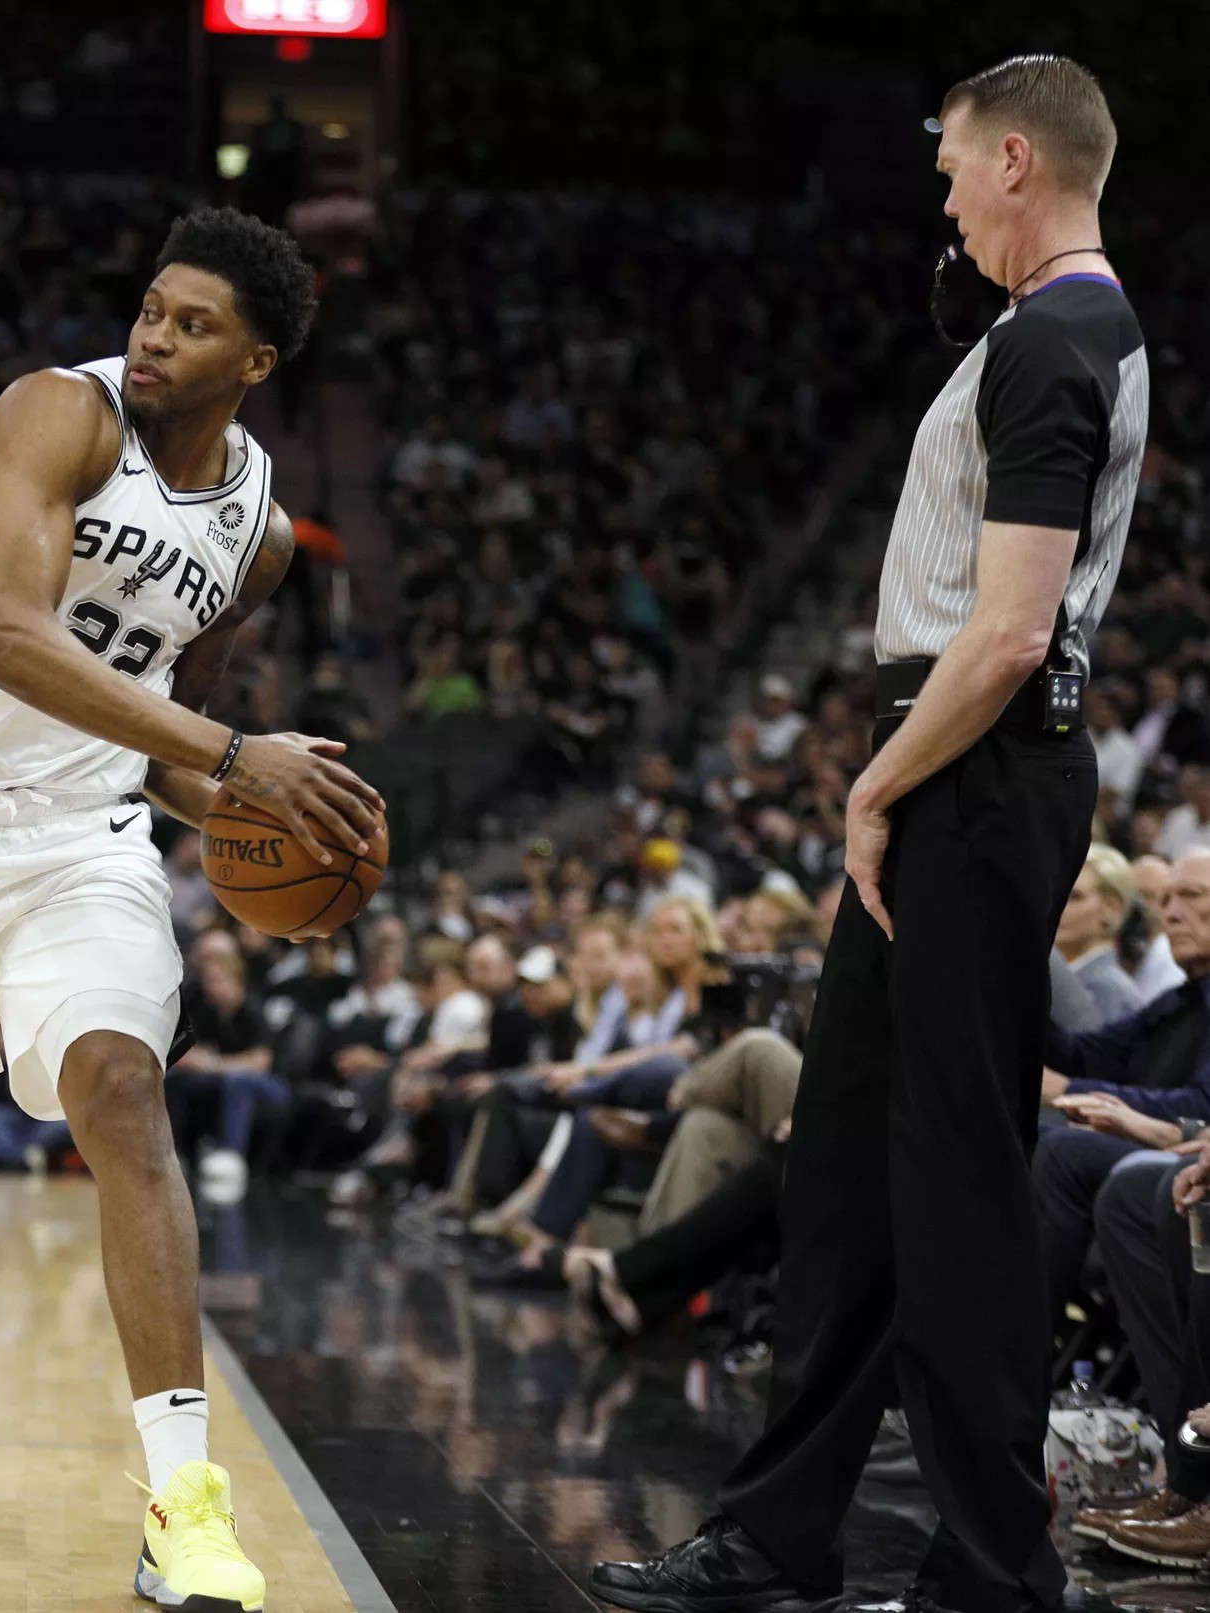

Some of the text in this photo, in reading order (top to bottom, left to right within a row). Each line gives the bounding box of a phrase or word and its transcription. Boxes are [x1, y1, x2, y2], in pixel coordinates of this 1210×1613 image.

[205, 519, 240, 554] Frost
[74, 517, 226, 630] SPURS
[68, 598, 166, 681] 22
[203, 834, 285, 869] SPALDI
